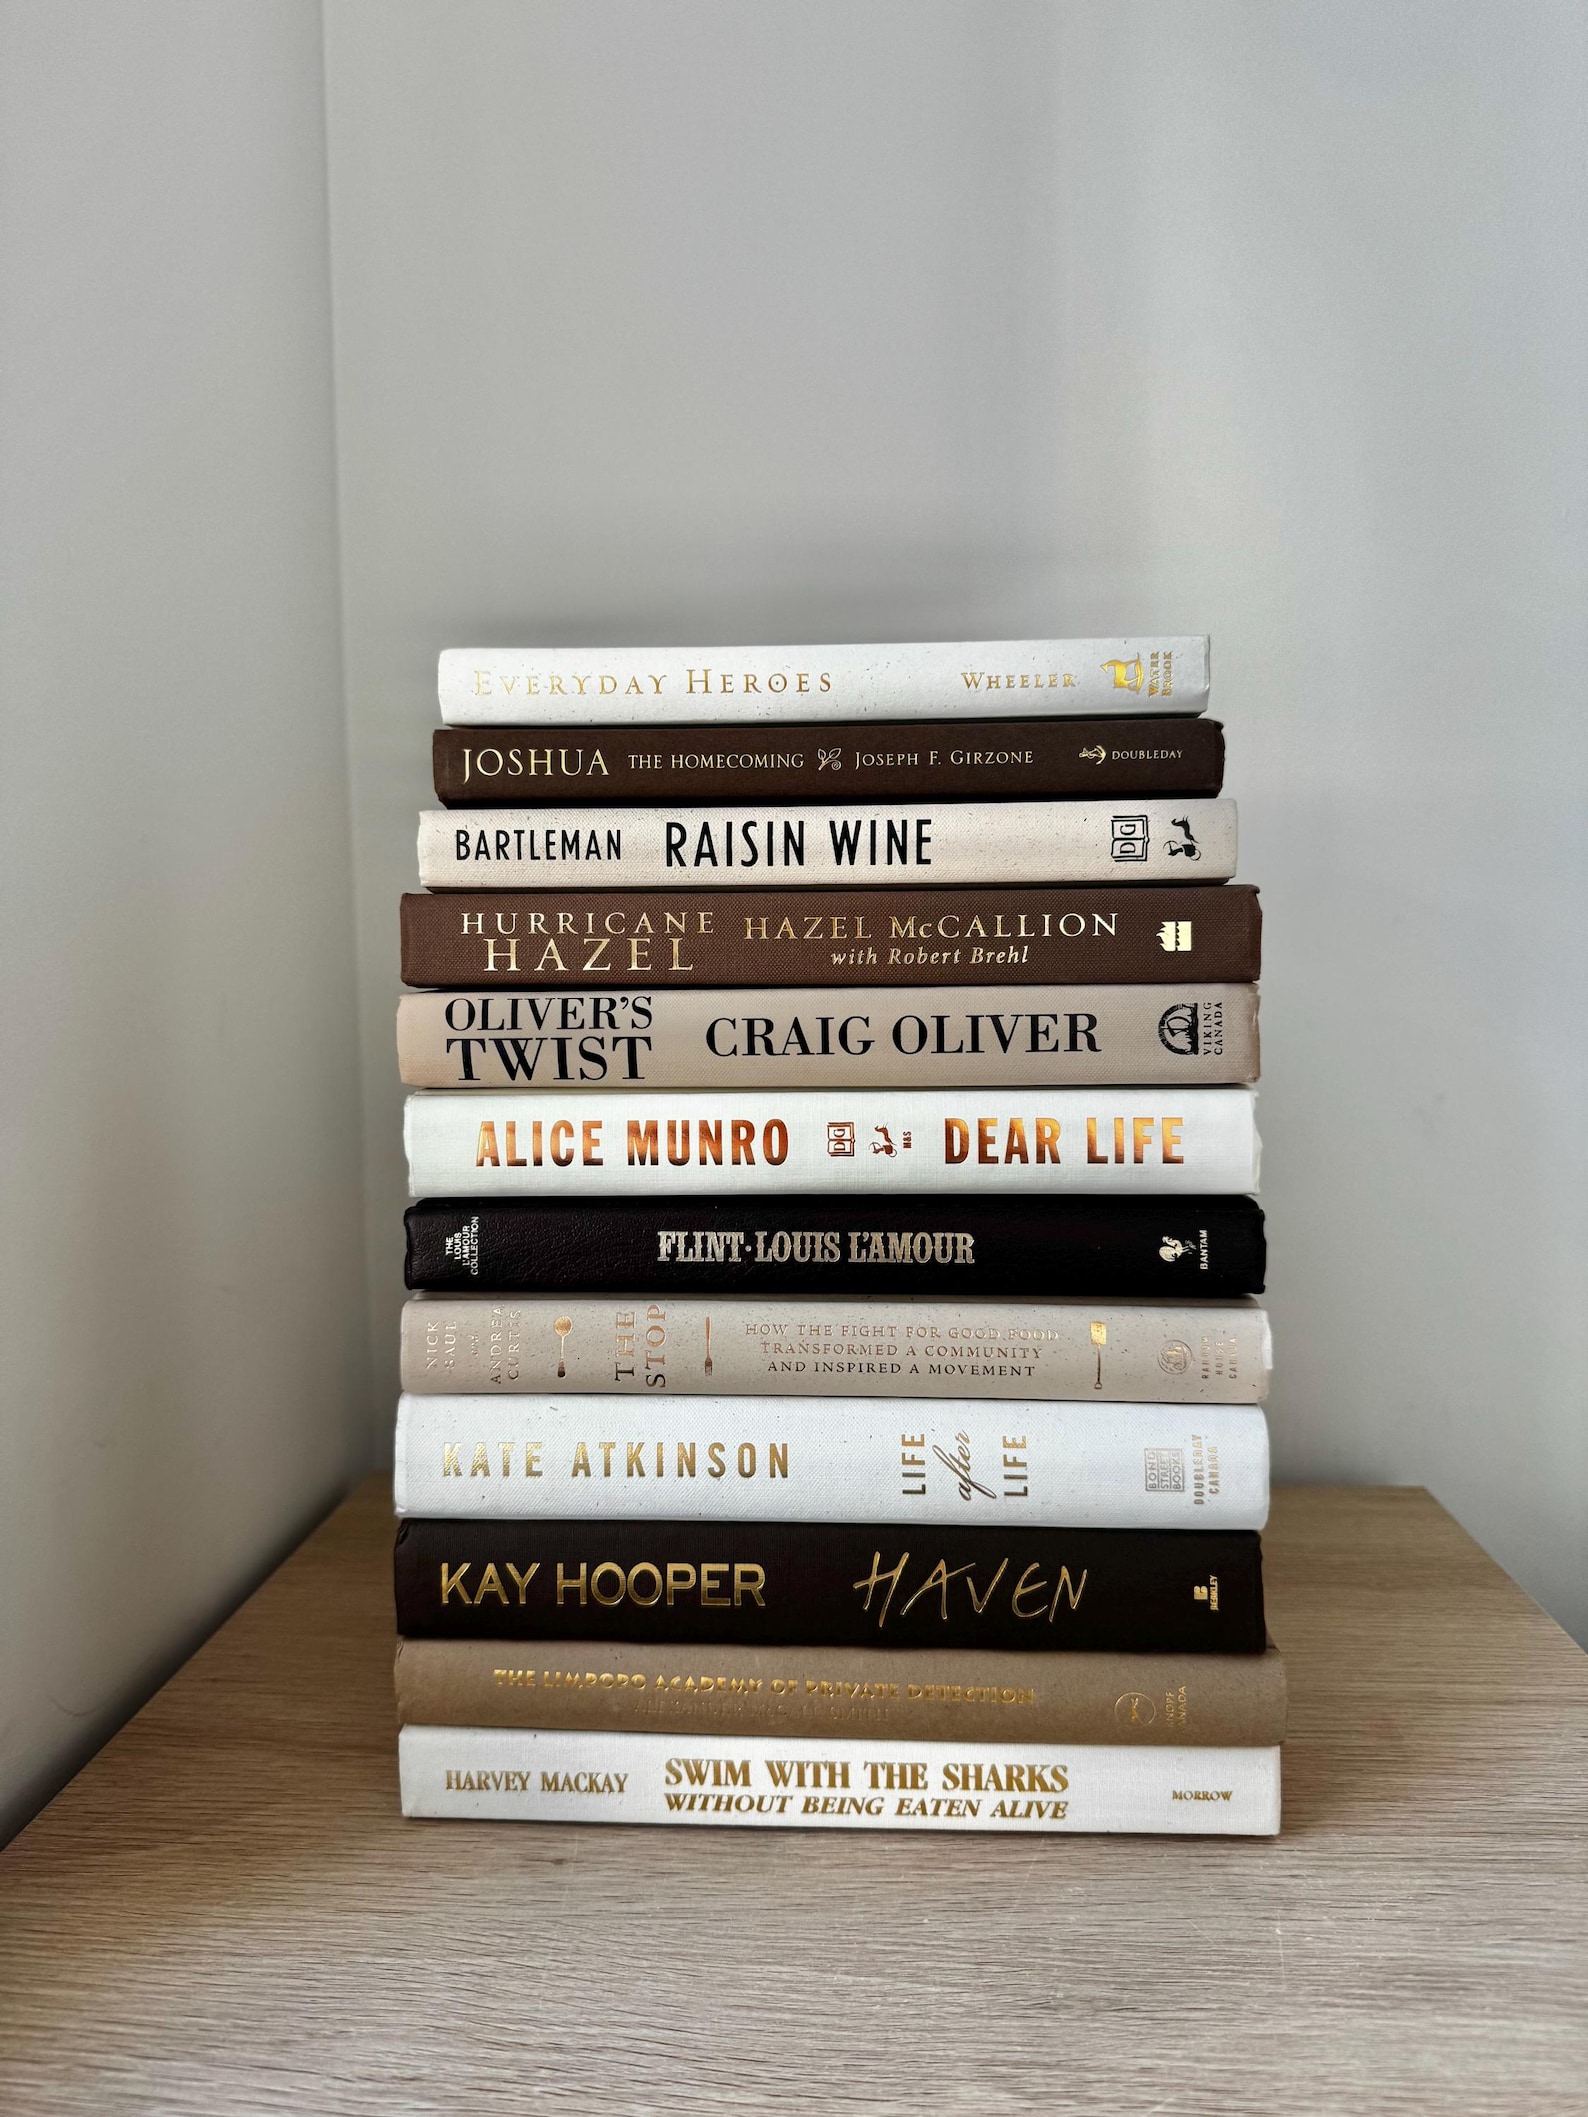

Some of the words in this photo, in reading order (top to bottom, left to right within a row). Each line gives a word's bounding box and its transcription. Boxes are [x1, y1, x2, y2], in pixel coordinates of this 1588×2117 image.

[473, 668, 668, 697] EVERYDAY
[685, 668, 832, 696] HEROES
[961, 672, 1077, 691] WHEELER
[1147, 651, 1160, 697] WATER
[1161, 650, 1174, 697] BROOK
[461, 747, 610, 785] JOSHUA
[628, 754, 663, 770] THE
[671, 752, 805, 771] HOMECOMING
[854, 750, 920, 770] JOSEPH
[928, 750, 943, 766] F.
[950, 749, 1035, 766] GIRZONE
[1111, 748, 1184, 761] DOUBLEDAY
[455, 828, 622, 862] BARTLEMAN
[665, 820, 806, 868] RAISIN
[829, 818, 933, 866] WINE
[460, 911, 715, 936] HURRICANE
[744, 915, 873, 941] HAZEL
[889, 912, 1120, 940] McCALLION
[483, 936, 695, 973] HAZEL
[831, 947, 878, 966] with
[887, 946, 962, 966] Robert
[969, 944, 1030, 965] Brehl
[444, 995, 654, 1033] OLIVER'S
[1203, 1002, 1212, 1056] VIKING
[1214, 1002, 1223, 1056] CANADA
[705, 1015, 876, 1058] CRAIG
[891, 1011, 1103, 1056] OLIVER
[445, 1035, 653, 1081] TWIST
[475, 1119, 604, 1168] ALICE
[626, 1117, 790, 1167] MUNRO
[902, 1131, 912, 1149] M&S
[944, 1116, 1062, 1165] DEAR
[1086, 1115, 1186, 1165] LIFE
[445, 1236, 454, 1256] THE
[453, 1231, 462, 1260] LOUIS
[462, 1225, 471, 1266] L'AMOUR
[470, 1216, 480, 1276] COLLECTION
[847, 1230, 976, 1265] L'AMOUR
[1199, 1229, 1209, 1270] BANTAM
[425, 1320, 440, 1370] NICK
[444, 1321, 458, 1370] SAUL
[490, 1305, 504, 1385] ANDREA
[506, 1310, 522, 1381] CURTIS
[614, 1310, 636, 1382] THE
[645, 1304, 668, 1389] STOP
[745, 1323, 790, 1337] HOW
[797, 1324, 835, 1338] THE
[841, 1324, 899, 1339] FIGHT
[906, 1325, 943, 1339] FOR
[948, 1325, 1001, 1341] GOOD
[1007, 1327, 1061, 1342] FOOD
[760, 1340, 899, 1357] TRANSFORMED
[906, 1344, 918, 1357] A
[924, 1345, 1044, 1360] COMMUNITY
[767, 1360, 808, 1374] AND
[814, 1361, 902, 1375] INSPIRED
[909, 1362, 921, 1375] A
[928, 1363, 1037, 1378] MOVEMENT
[442, 1441, 545, 1478] KATE
[571, 1441, 790, 1479] ATKINSON
[901, 1433, 927, 1496] LIFE
[931, 1429, 998, 1502] after
[1002, 1434, 1030, 1497] LIFE
[1147, 1451, 1158, 1489] BOND
[1172, 1451, 1182, 1490] BOOKS
[1191, 1434, 1205, 1505] DOUBLEDAY
[1207, 1446, 1220, 1495] CANADA
[440, 1561, 542, 1606] KAY
[556, 1560, 768, 1608] HOOPER
[852, 1550, 1089, 1629] HAVEN
[493, 1668, 537, 1688] THE
[543, 1670, 648, 1691] LIMPOPO
[654, 1673, 764, 1696] ACADEMY
[769, 1678, 799, 1696] OF
[805, 1679, 901, 1700] PRIVATE
[907, 1683, 1035, 1704] DETECTION
[445, 1768, 533, 1793] HARVEY
[540, 1770, 630, 1795] MACKAY
[664, 1757, 753, 1788] SWIM
[763, 1759, 851, 1790] WITH
[863, 1760, 929, 1791] THE
[941, 1762, 1070, 1794] SHARKS
[1171, 1788, 1234, 1802] MORROW
[663, 1792, 794, 1815] WITHOUT
[801, 1795, 884, 1817] BEING
[894, 1796, 982, 1819] EATEN
[988, 1798, 1070, 1821] ALIVE
